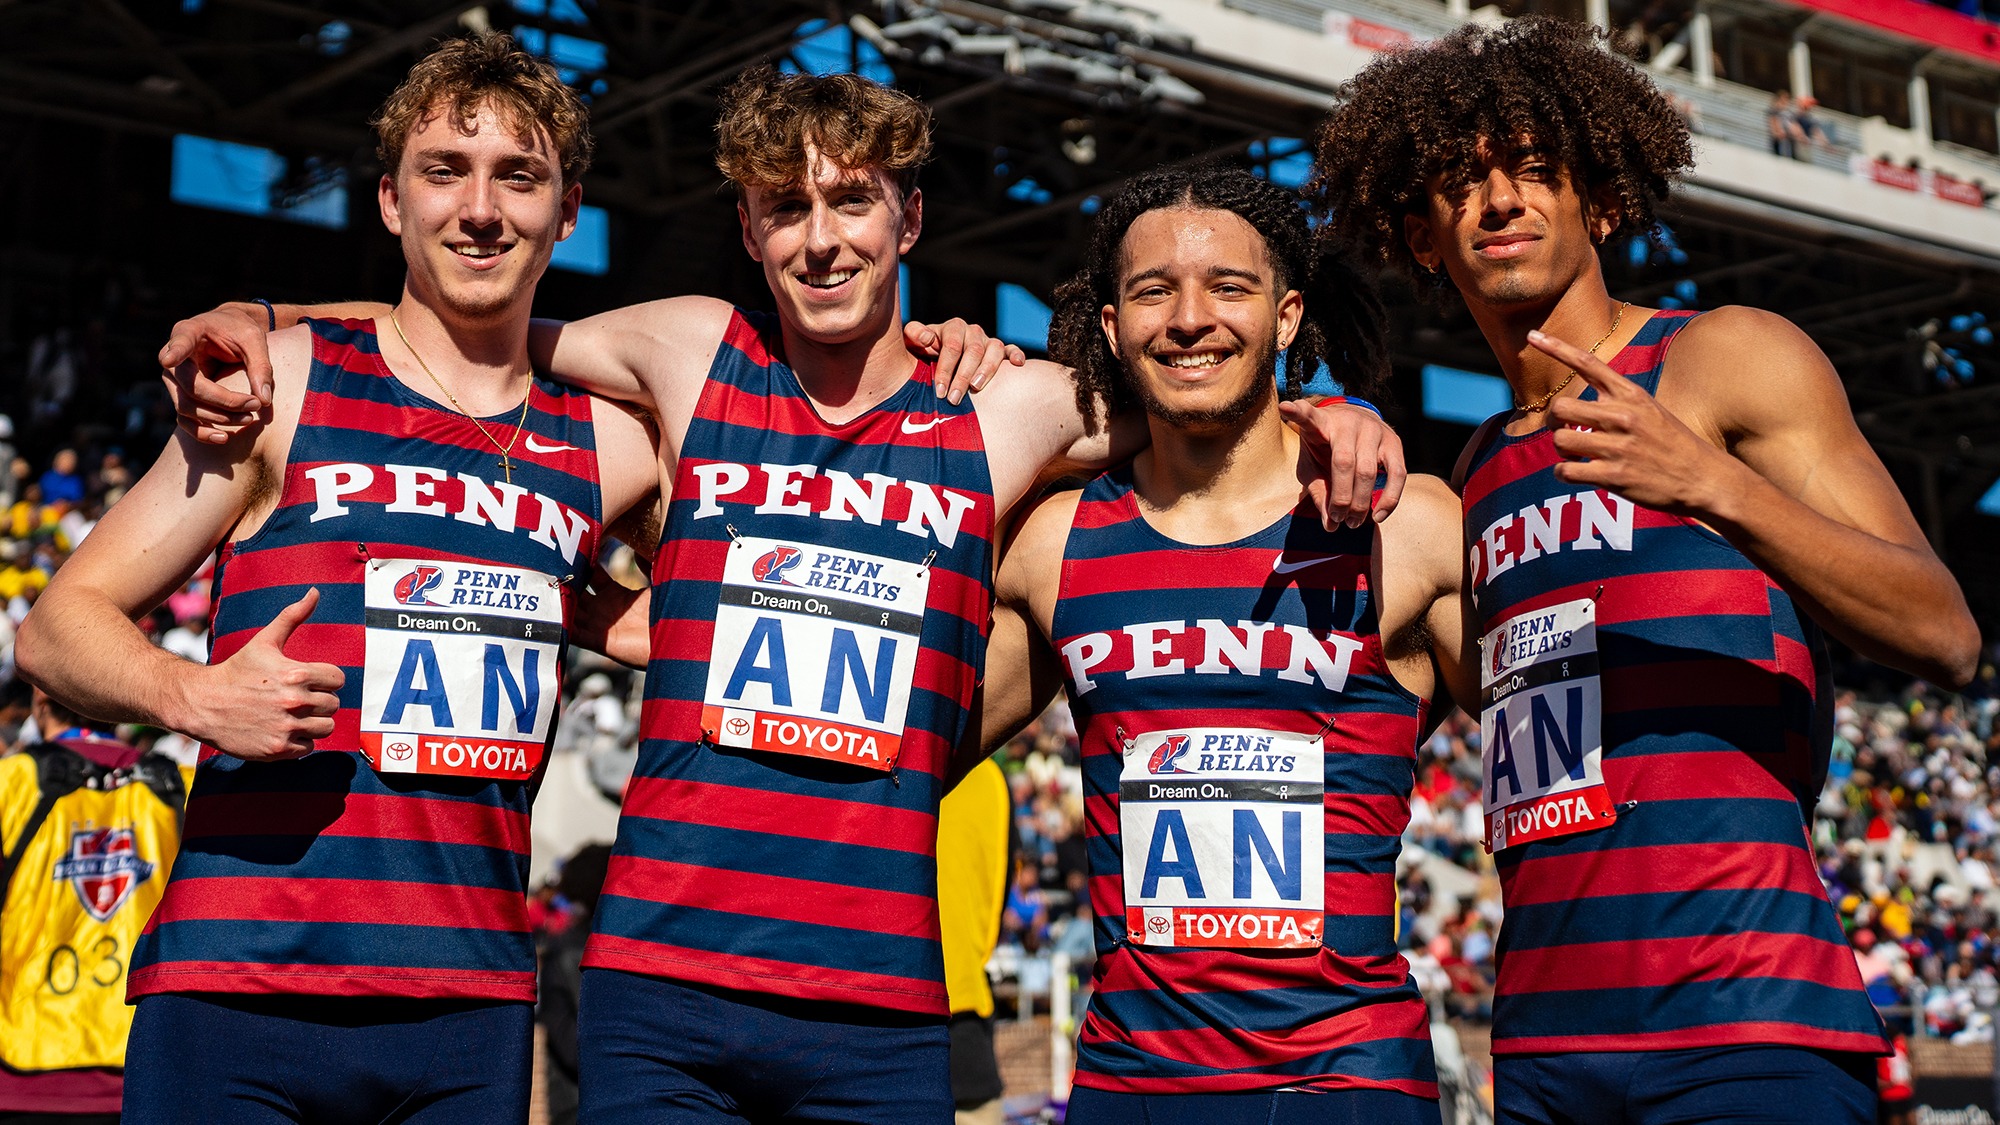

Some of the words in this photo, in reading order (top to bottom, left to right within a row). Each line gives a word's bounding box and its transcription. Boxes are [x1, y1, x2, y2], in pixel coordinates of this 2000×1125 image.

[305, 463, 590, 566] PENN
[692, 462, 976, 550] PENN
[1470, 490, 1635, 610] PENN
[454, 569, 521, 591] PENN
[811, 552, 884, 579] PENN
[450, 589, 540, 612] RELAYS
[805, 570, 901, 602] RELAYS
[751, 591, 802, 612] Dream
[804, 598, 832, 616] On.
[397, 614, 449, 631] Dream
[452, 616, 481, 632] On.
[1510, 613, 1556, 643] PENN
[1061, 618, 1364, 698] PENN
[1509, 632, 1572, 662] RELAYS
[1493, 678, 1511, 701] Dream
[1511, 674, 1527, 692] On.
[761, 719, 880, 761] TOYOTA
[1201, 734, 1275, 752] PENN
[425, 741, 527, 772] TOYOTA
[1197, 754, 1296, 773] RELAYS
[1149, 784, 1198, 799] Dream
[1201, 784, 1230, 799] On.
[1507, 795, 1595, 837] TOYOTA
[1179, 913, 1302, 941] TOYOTA
[47, 935, 123, 995] 03
